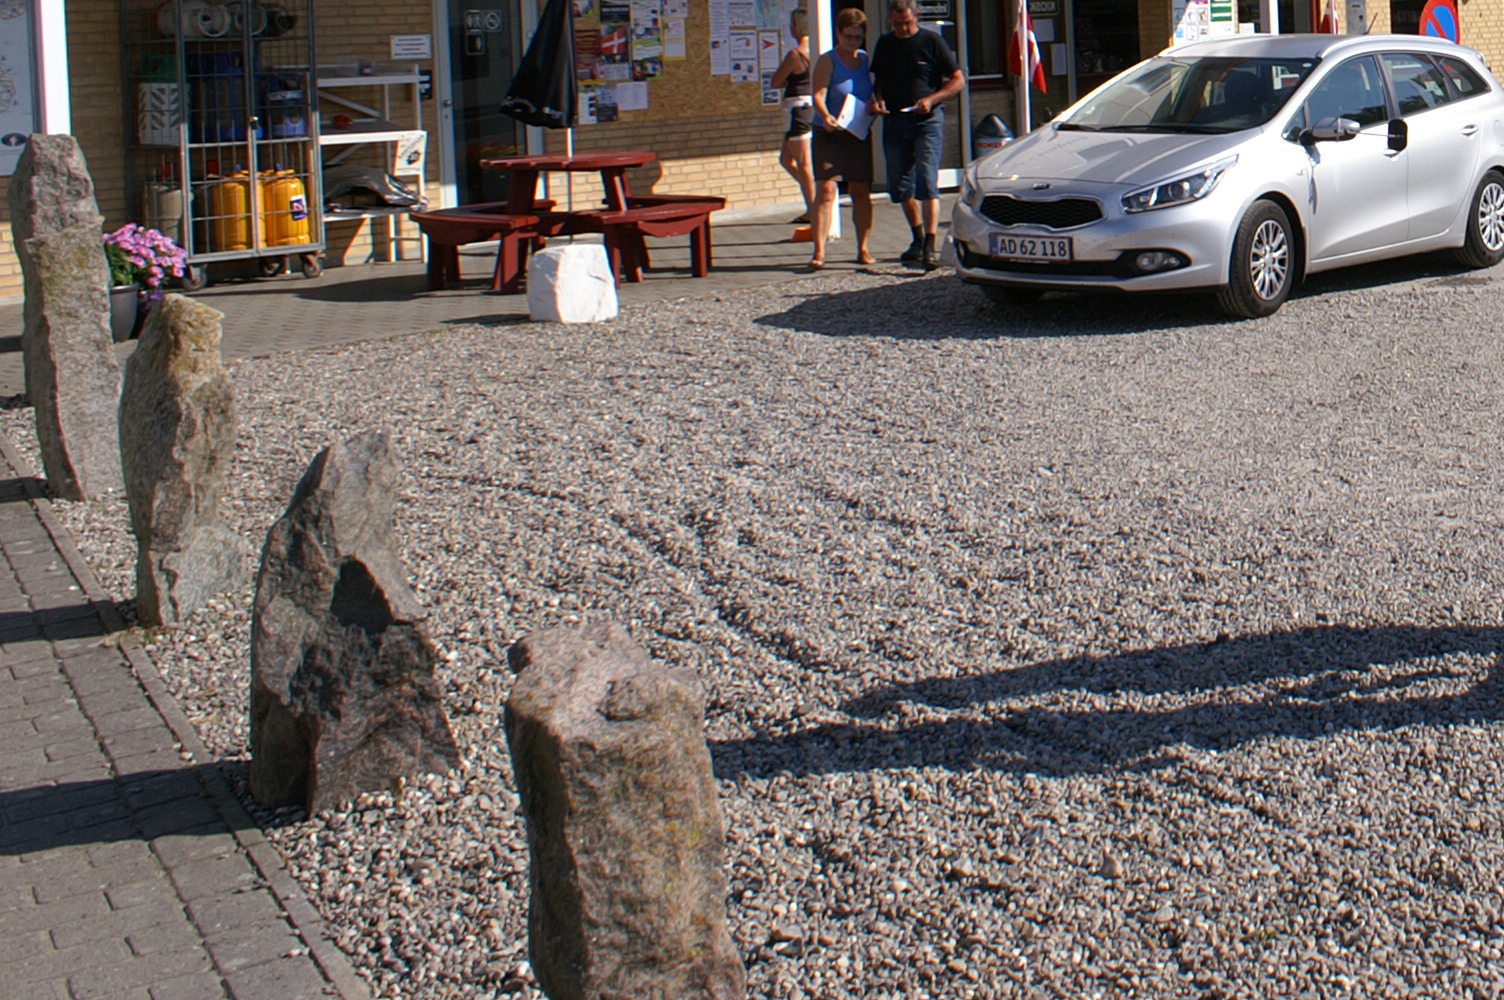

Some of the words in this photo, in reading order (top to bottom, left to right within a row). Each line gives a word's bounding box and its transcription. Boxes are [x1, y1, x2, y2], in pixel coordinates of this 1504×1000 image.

[1000, 238, 1017, 254] AD
[1019, 239, 1037, 256] 62
[1041, 241, 1067, 257] 118
